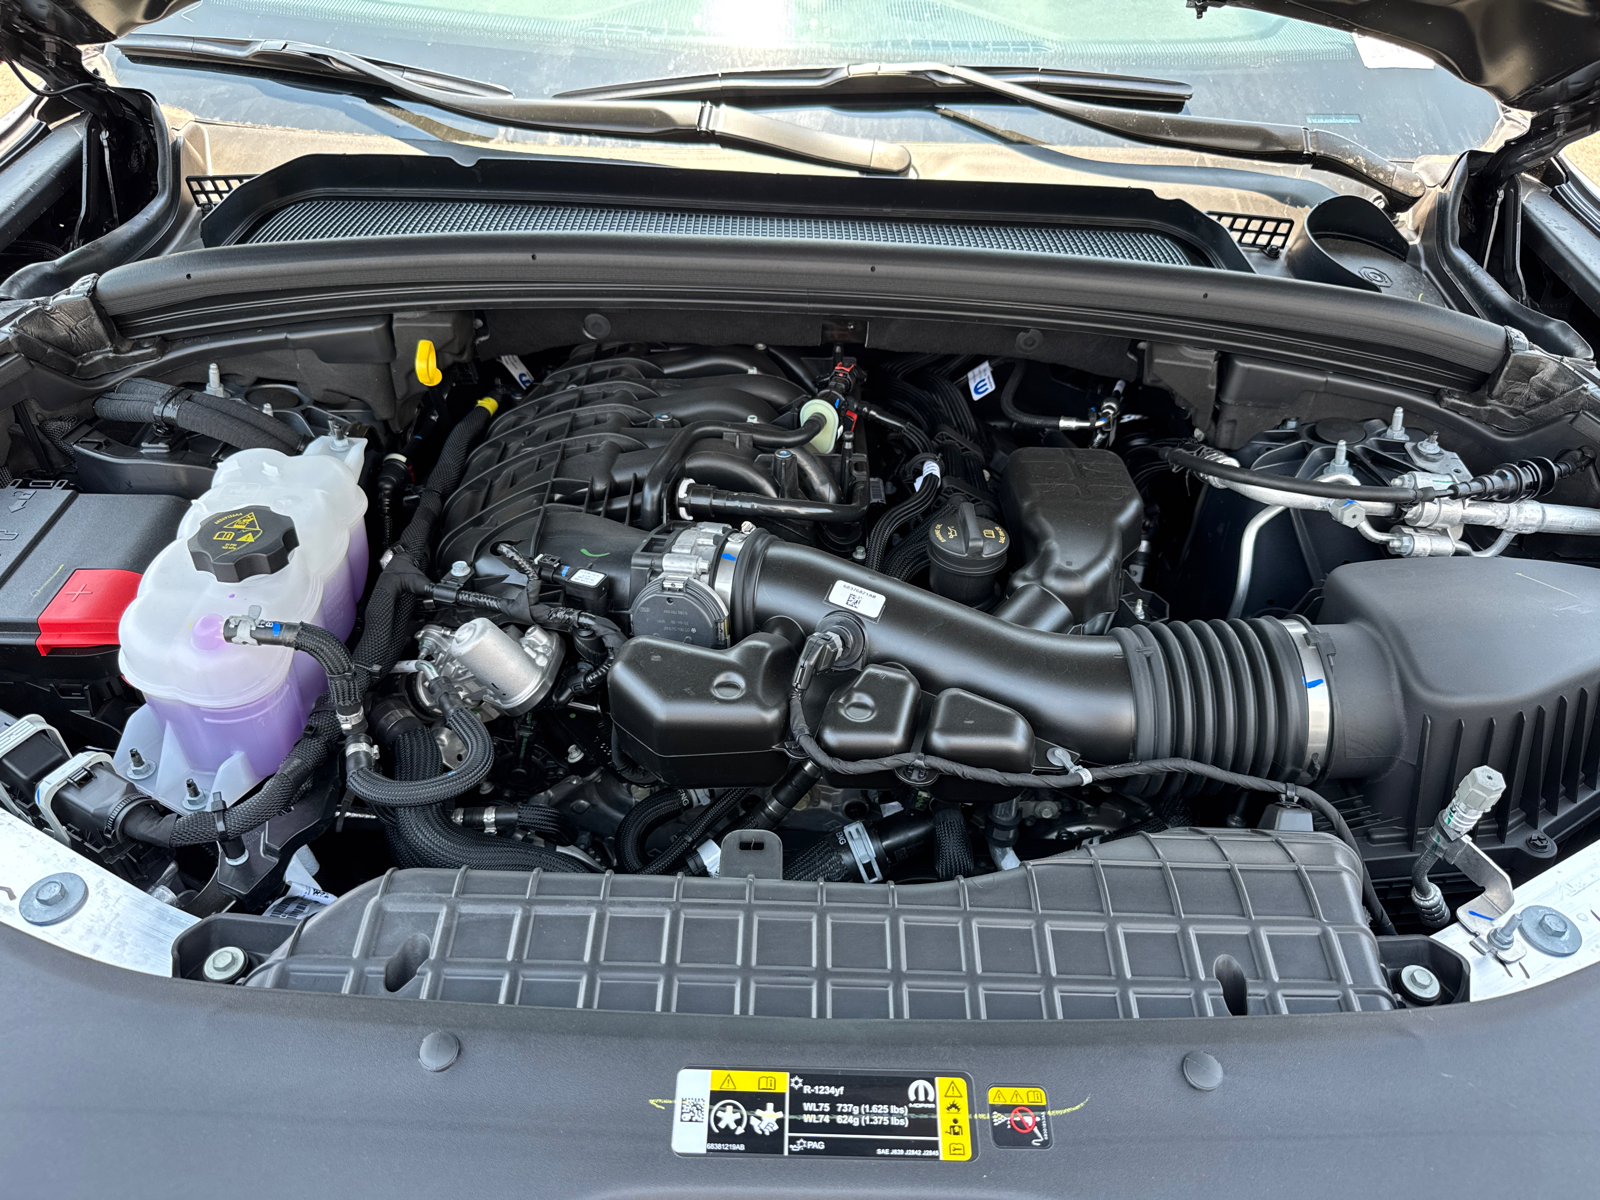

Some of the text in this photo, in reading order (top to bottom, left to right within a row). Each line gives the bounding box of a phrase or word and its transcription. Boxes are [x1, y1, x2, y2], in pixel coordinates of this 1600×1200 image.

[802, 1085, 845, 1097] R-1234yf
[802, 1102, 909, 1116] WL75 737g (1.625 lbs)
[802, 1113, 909, 1128] WL74 624g (1.375 lbs)
[807, 1140, 825, 1150] PAG
